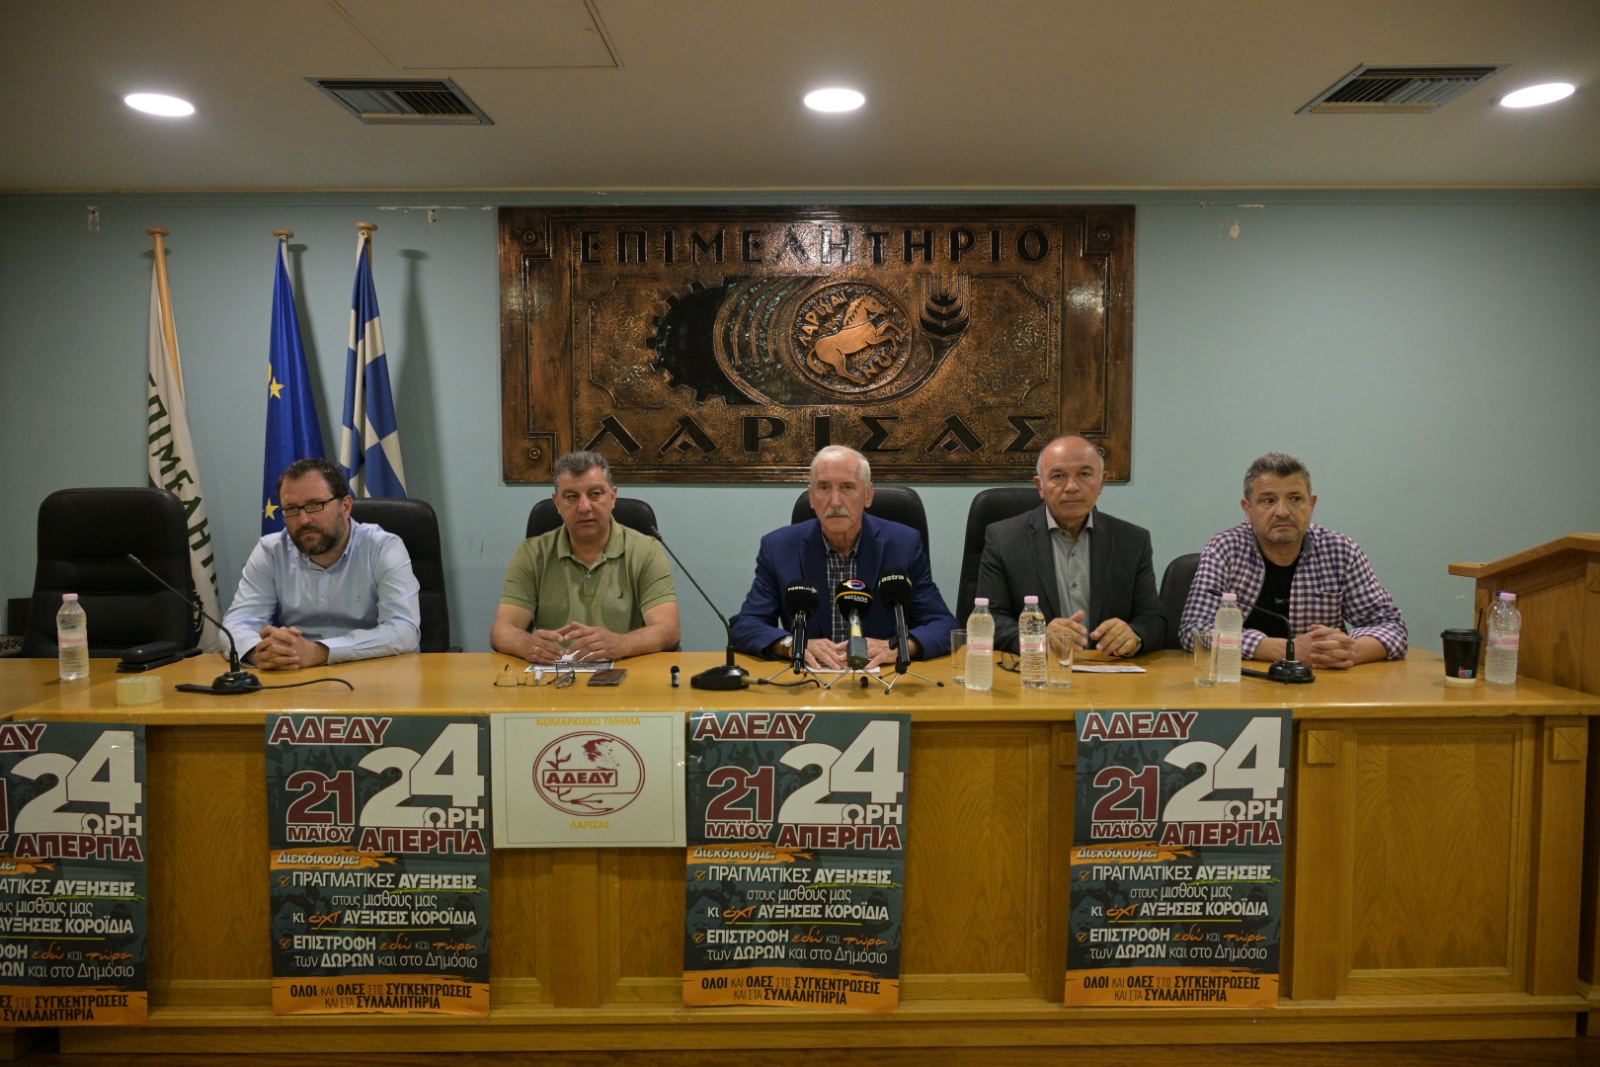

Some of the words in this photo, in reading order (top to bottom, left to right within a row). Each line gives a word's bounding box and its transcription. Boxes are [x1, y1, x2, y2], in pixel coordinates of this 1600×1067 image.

[581, 226, 1052, 265] ΕΠΙΜΕΛΗΤΗΡΙΟ
[586, 415, 1049, 454] ΛΑΡΙΣΑΣ
[268, 716, 392, 745] ΑΔΕΔΥ
[536, 718, 600, 727] ΝΟΜΑΡΧΙΑΚΟ
[604, 717, 641, 726] ΤΜΗΜΑ
[693, 713, 816, 742] ΑΔΕΔΥ
[1080, 712, 1198, 742] ΑΔΕΔΥ
[358, 723, 484, 827] 24
[546, 772, 614, 784] ΑΔΕΔΥ
[778, 720, 904, 824] 24
[1162, 716, 1285, 822] 24
[10, 730, 142, 833] 24
[286, 770, 355, 825] 21
[706, 766, 775, 822] 21
[1092, 766, 1160, 822] 21
[423, 807, 484, 829] ΩΡΗ
[841, 803, 902, 824] ΩΡΗ
[1224, 800, 1283, 820] ΩΡΗ
[80, 814, 142, 836] ΩΡΗ
[286, 824, 355, 842] ΜΑΪΟΥ
[706, 820, 773, 839] ΜΑΪΟΥ
[1092, 820, 1158, 838] ΜΑΪΟΥ
[1160, 821, 1282, 846] ΑΠΕΡΓΙΑ
[358, 828, 486, 854] ΑΠΕΡΓΙΑ
[776, 824, 902, 850] ΑΠΕΡΓΙΑ
[14, 833, 144, 862] ΑΠΕΡΓΙΑ
[292, 872, 395, 888] ΠΡΑΓΜΑΤΙΚΕΣ
[399, 874, 476, 889] ΑΥΞΗΣΕΙΣ
[708, 866, 811, 883] ΠΡΑΓΜΑΤΙΚΕΣ
[814, 868, 892, 884] ΑΥΞΗΣΕΙΣ
[1092, 865, 1192, 880] ΠΡΑΓΜΑΤΙΚΕΣ
[1196, 865, 1271, 880] ΑΥΞΗΣΕΙΣ
[0, 878, 51, 894] ΑΤΙΚΕΣ
[53, 880, 135, 896] ΑΥΞΗΣΕΙΣ
[747, 889, 775, 902] στους
[778, 885, 827, 902] μισθούς
[830, 890, 852, 902] μας
[1130, 887, 1158, 899] στους
[1160, 883, 1208, 900] μισθούς
[1210, 886, 1232, 900] μας
[16, 897, 66, 916] μισθούς
[70, 902, 93, 917] μας
[332, 894, 360, 906] στους
[363, 890, 412, 910] μισθούς
[415, 895, 437, 910] μας
[1091, 906, 1102, 916] κι
[1140, 902, 1203, 916] ΑΥΞΗΣΕΙΣ
[1206, 898, 1268, 916] ΚΟΡΟΪΔΙΑ
[292, 912, 304, 923] κι
[344, 910, 408, 925] ΑΥΞΗΣΕΙΣ
[412, 908, 476, 925] ΚΟΡΟΪΔΙΑ
[708, 907, 719, 917] κι
[758, 905, 822, 918] ΑΥΞΗΣΕΙΣ
[825, 902, 889, 920] ΚΟΡΟΪΔΙΑ
[65, 916, 134, 934] ΚΟΡΟΪΔΙΑ
[293, 935, 376, 950] ΕΠΙΣΤΡΟΦΗ
[415, 940, 430, 950] και
[706, 929, 788, 944] ΕΠΙΣΤΡΟΦΗ
[826, 935, 840, 944] και
[1090, 928, 1170, 942] ΕΠΙΣΤΡΟΦΗ
[1206, 932, 1220, 942] και
[68, 951, 82, 960] και
[294, 956, 318, 967] των
[320, 954, 374, 967] ΔΩΡΩΝ
[378, 954, 397, 966] και
[400, 955, 422, 966] στο
[425, 952, 478, 970] Δημόσιο
[707, 949, 730, 960] των
[734, 946, 785, 960] ΔΩΡΩΝ
[788, 948, 807, 960] και
[810, 950, 832, 960] στο
[834, 948, 888, 964] Δημόσιο
[1090, 948, 1114, 960] των
[1115, 945, 1166, 958] ΔΩΡΩΝ
[1170, 948, 1188, 958] και
[1190, 948, 1212, 958] στο
[1215, 946, 1267, 962] Δημόσιο
[28, 967, 48, 978] και
[50, 966, 74, 978] στο
[78, 962, 134, 980] Δημόσιο
[290, 984, 317, 997] ΟΛΟΙ
[336, 984, 364, 996] ΟΛΕΣ
[386, 984, 472, 998] ΣΥΓΚΕΝΤΡΩΣΕΙΣ
[702, 978, 728, 990] ΟΛΟΙ
[746, 976, 773, 988] ΟΛΕΣ
[794, 976, 880, 994] ΣΥΓΚΕΝΤΡΩΣΕΙΣ
[1084, 976, 1109, 988] ΟΛΟΙ
[1127, 976, 1154, 988] ΟΛΕΣ
[1174, 976, 1260, 989] ΣΥΓΚΕΝΤΡΩΣΕΙΣ
[35, 994, 128, 1008] ΣΥΓΚΕΝΤΡΩΣΕΙΣ
[356, 996, 440, 1009] ΣΥΛΛΑΛΗΤΗΡΙΑ
[764, 988, 846, 1004] ΣΥΛΛΑΛΗΤΗΡΙΑ
[1145, 989, 1227, 1002] ΣΥΛΛΑΛΗΤΗΡΙΑ
[4, 1008, 94, 1020] ΣΥΛΛΑΛΗΤΗΡΙΑ
